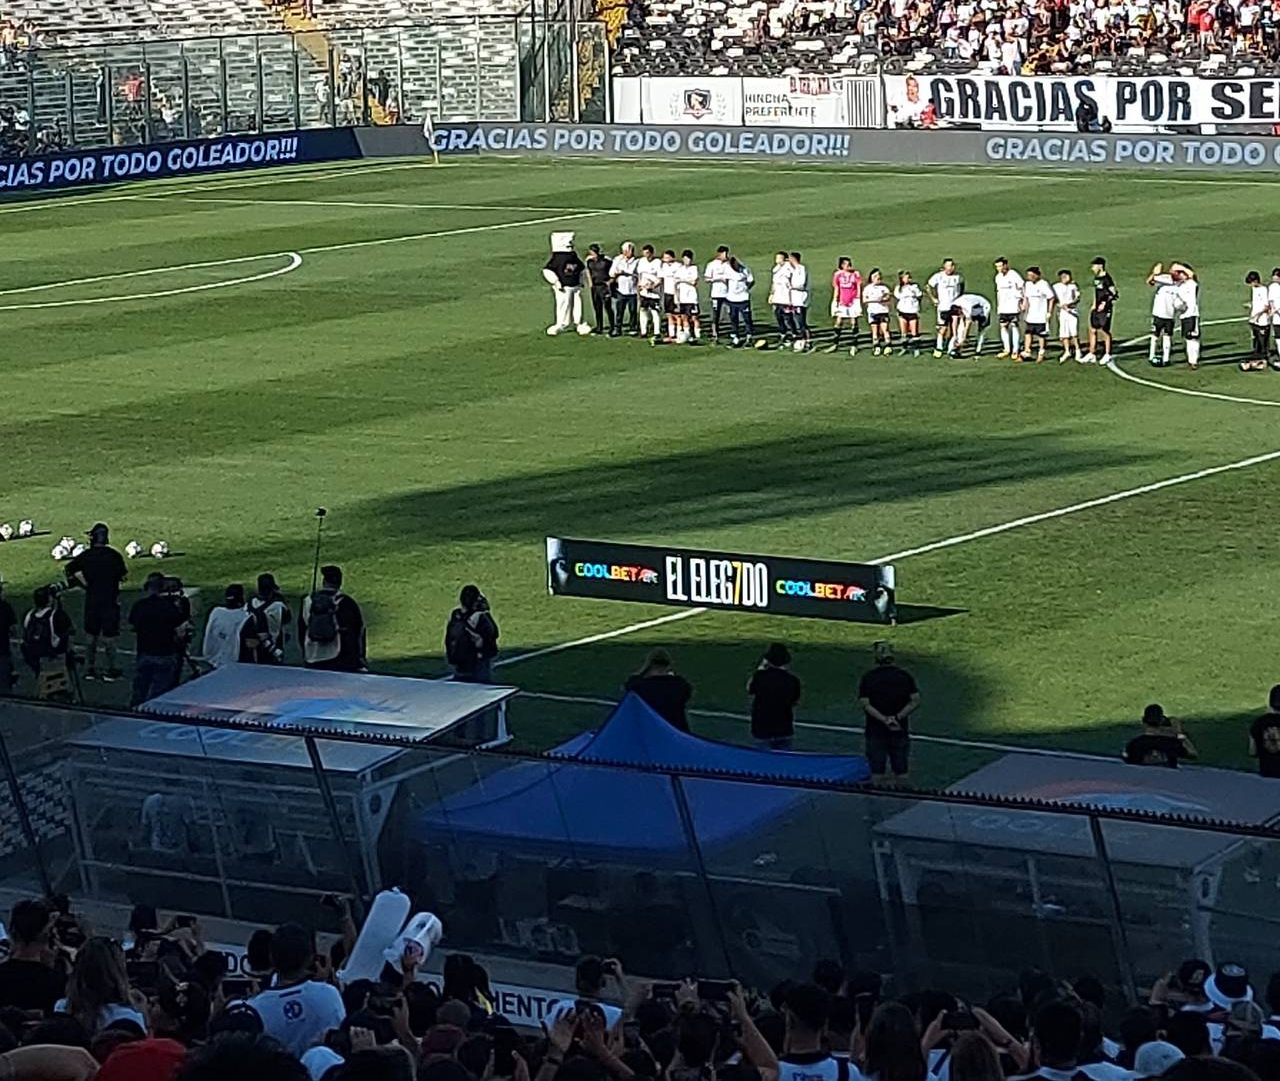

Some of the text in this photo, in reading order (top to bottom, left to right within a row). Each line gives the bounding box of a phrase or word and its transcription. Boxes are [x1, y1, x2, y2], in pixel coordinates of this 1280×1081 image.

[931, 78, 1096, 121] GRACIAS
[1117, 81, 1192, 121] POR
[48, 155, 96, 184] POR
[102, 149, 162, 179] TODO
[167, 136, 299, 172] GOLEADOR!!!
[431, 127, 851, 157] GRACIAS POR TODO GOLEADOR!!!
[985, 137, 1108, 162] GRACIAS
[1115, 140, 1175, 164] POR
[1181, 141, 1266, 167] TODO
[574, 561, 638, 582] COOLBET
[665, 555, 689, 602] EL
[776, 578, 844, 600] COOLBET
